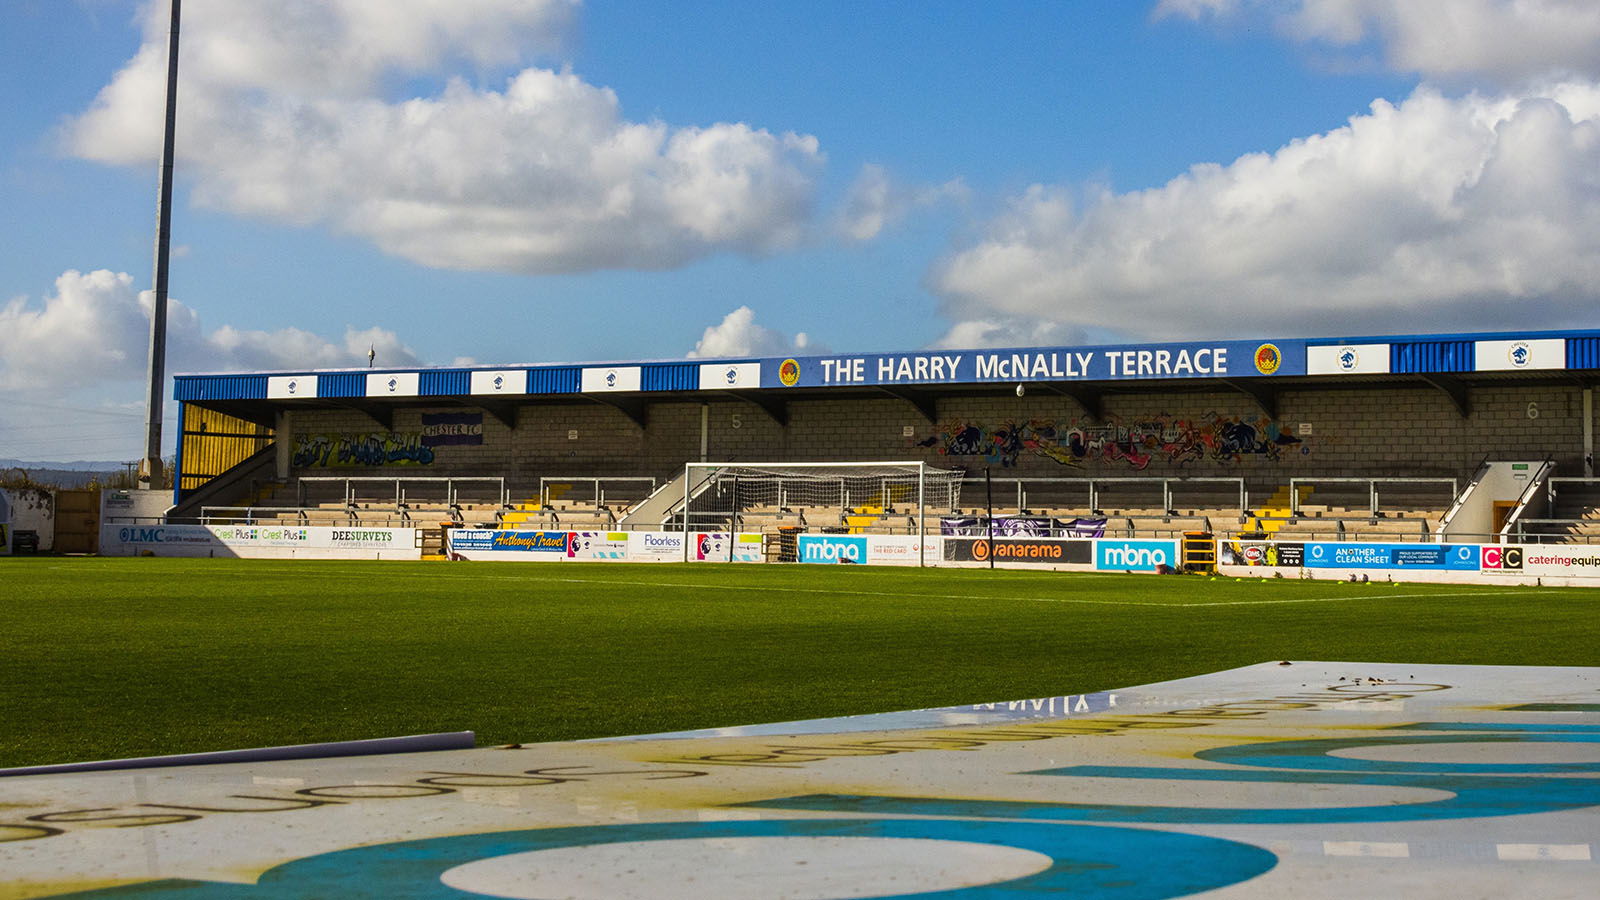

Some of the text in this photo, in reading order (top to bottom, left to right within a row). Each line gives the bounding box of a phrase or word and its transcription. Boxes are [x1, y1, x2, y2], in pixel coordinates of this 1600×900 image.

[821, 348, 1228, 384] THE HARRY McNALLY TERRACE
[1526, 402, 1539, 419] 6
[732, 414, 742, 429] 5
[423, 424, 466, 436] CHESTER
[129, 528, 164, 542] LMC
[214, 528, 234, 540] Crest
[235, 528, 250, 540] Plus
[262, 528, 298, 541] Crest Plus
[332, 530, 393, 542] DEESURVEYS
[493, 531, 566, 550] Anthony's Travel
[644, 534, 681, 547] Floorless
[805, 539, 859, 560] mbna
[991, 543, 1062, 558] vanarama
[1104, 544, 1166, 566] mbna
[1335, 548, 1375, 556] ANOTHER
[1364, 556, 1389, 564] SHEET
